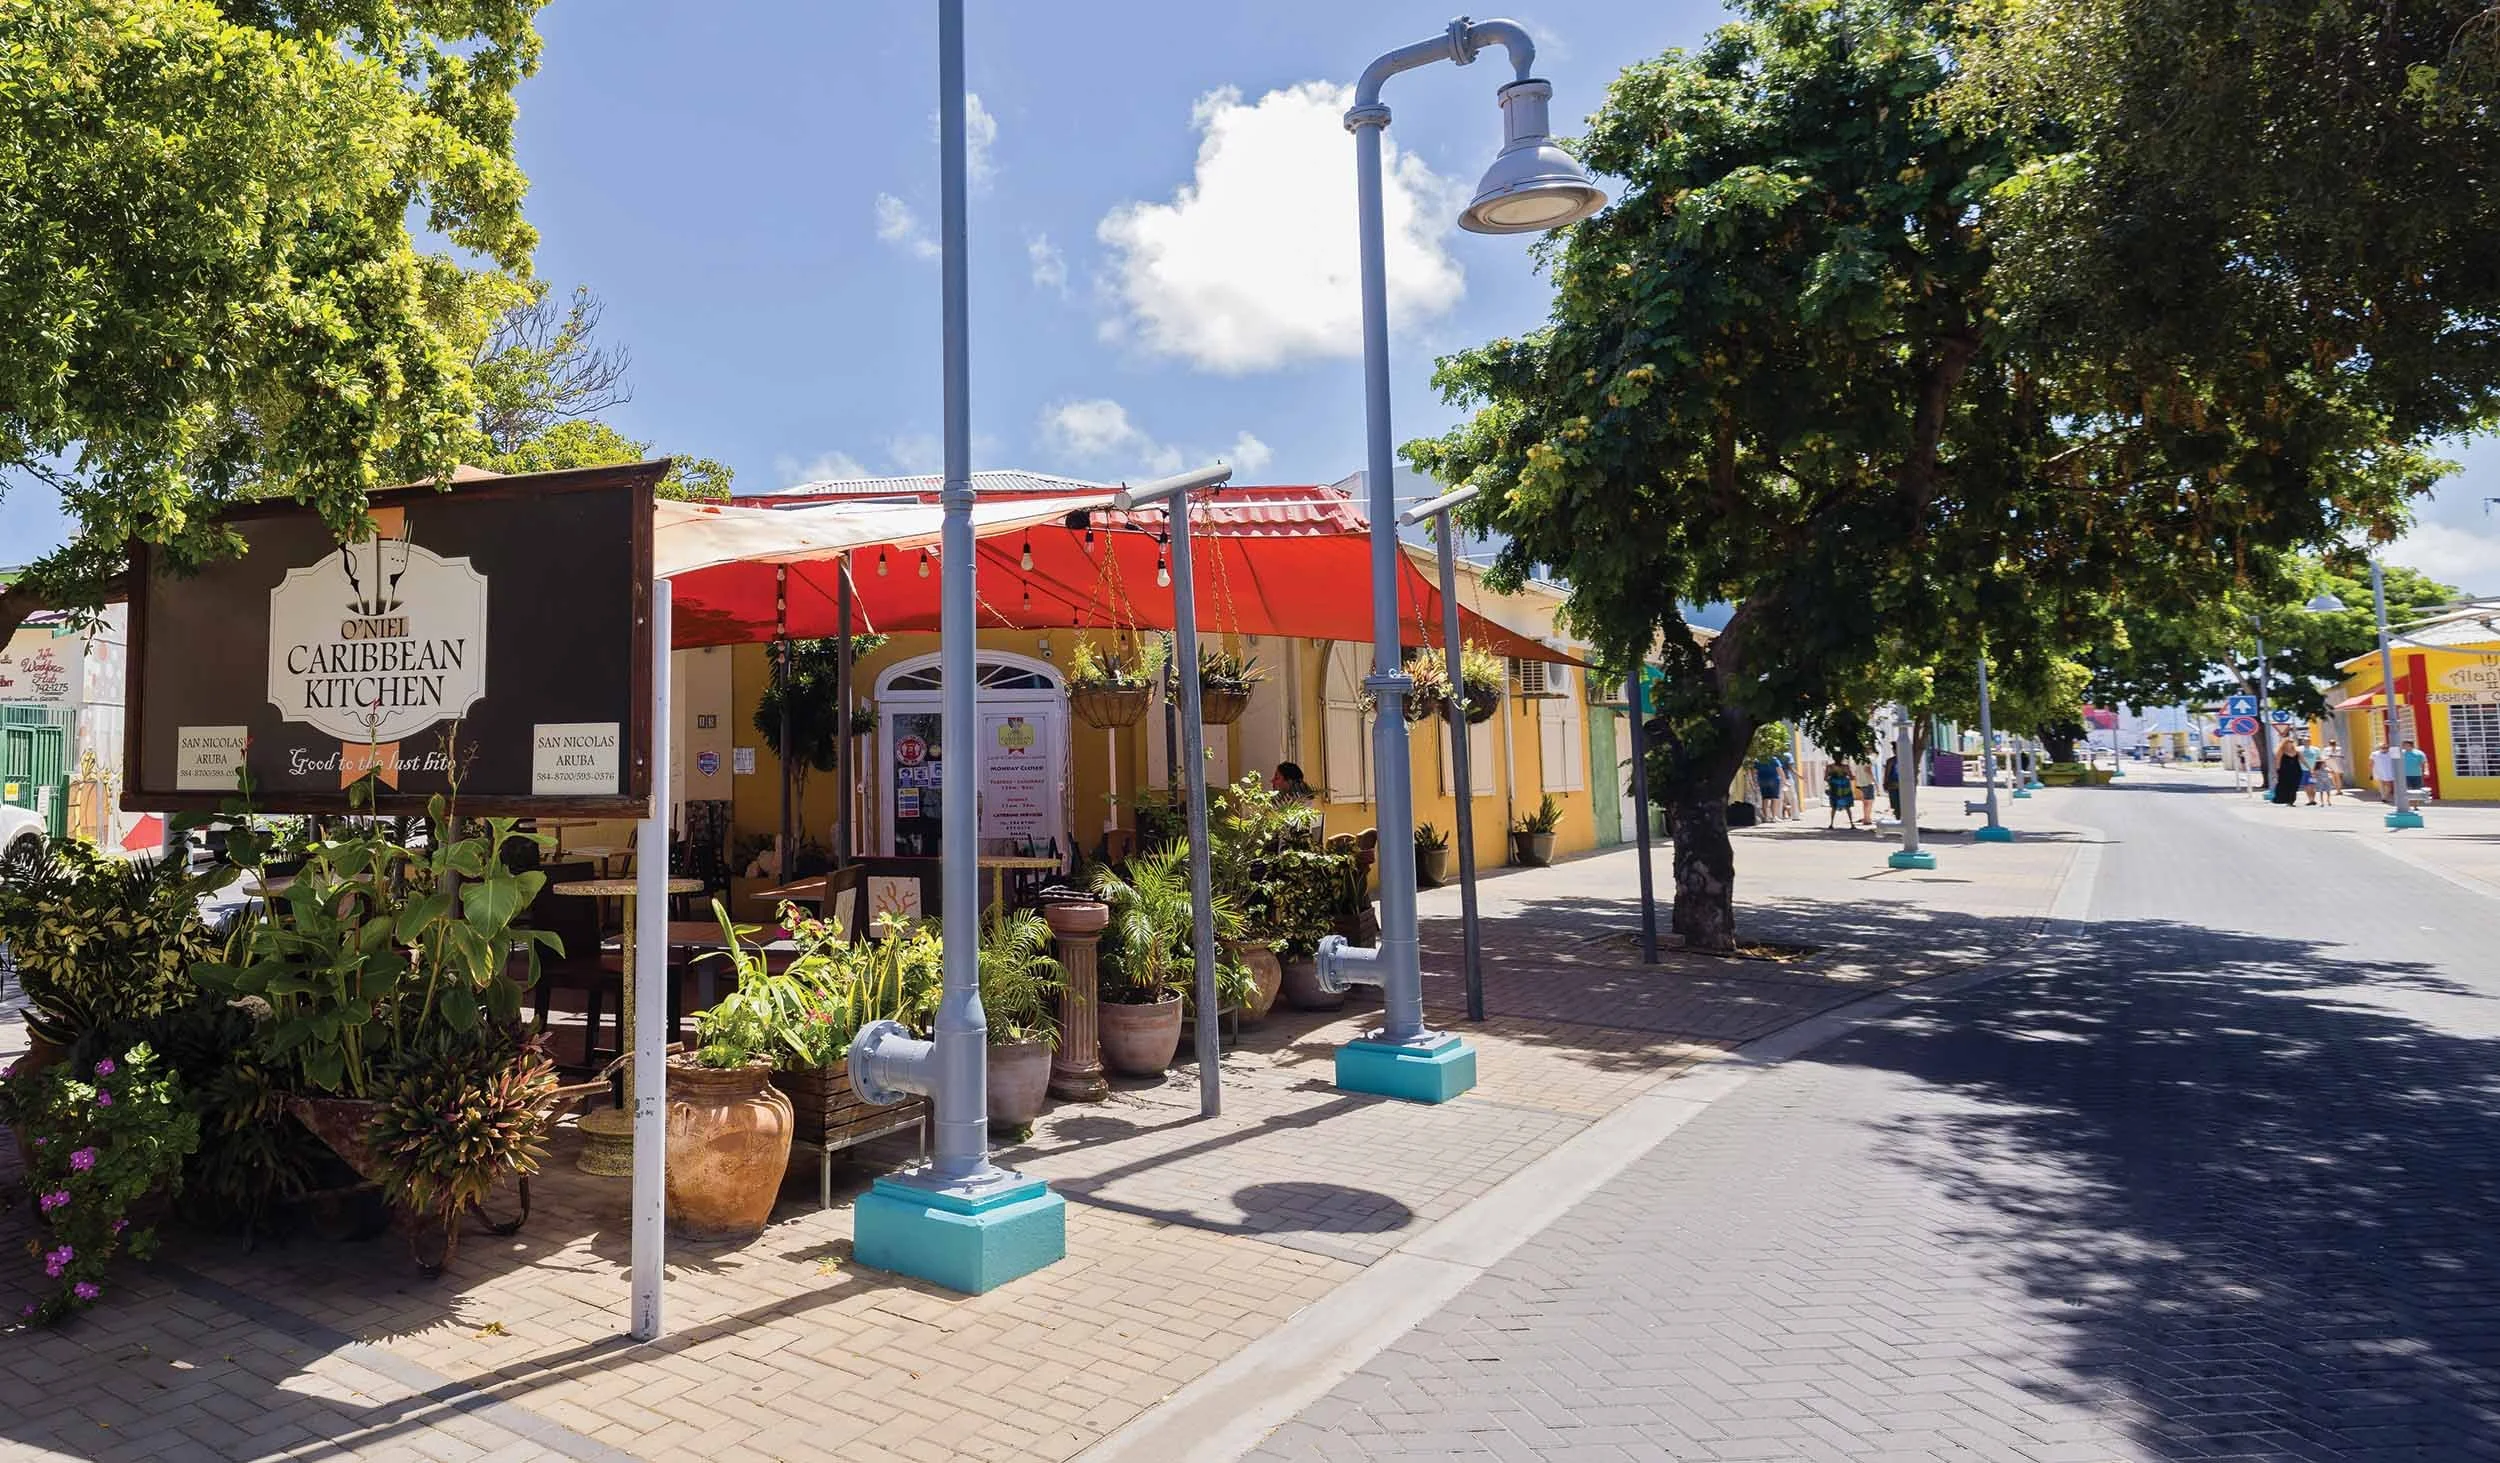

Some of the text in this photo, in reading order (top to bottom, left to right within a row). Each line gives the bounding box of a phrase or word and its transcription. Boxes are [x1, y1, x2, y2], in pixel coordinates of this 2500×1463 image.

[341, 617, 409, 640] O'NIEL
[287, 639, 465, 675] CARIBBEAN
[304, 675, 445, 709] KITCHEN
[181, 737, 244, 748] SAN NICOLAS
[538, 735, 615, 748] SAN NICOLAS
[196, 754, 228, 764] ARUBA
[289, 748, 341, 776] Good
[339, 757, 354, 771] to
[387, 751, 420, 771] last
[556, 754, 595, 766] ARUBA
